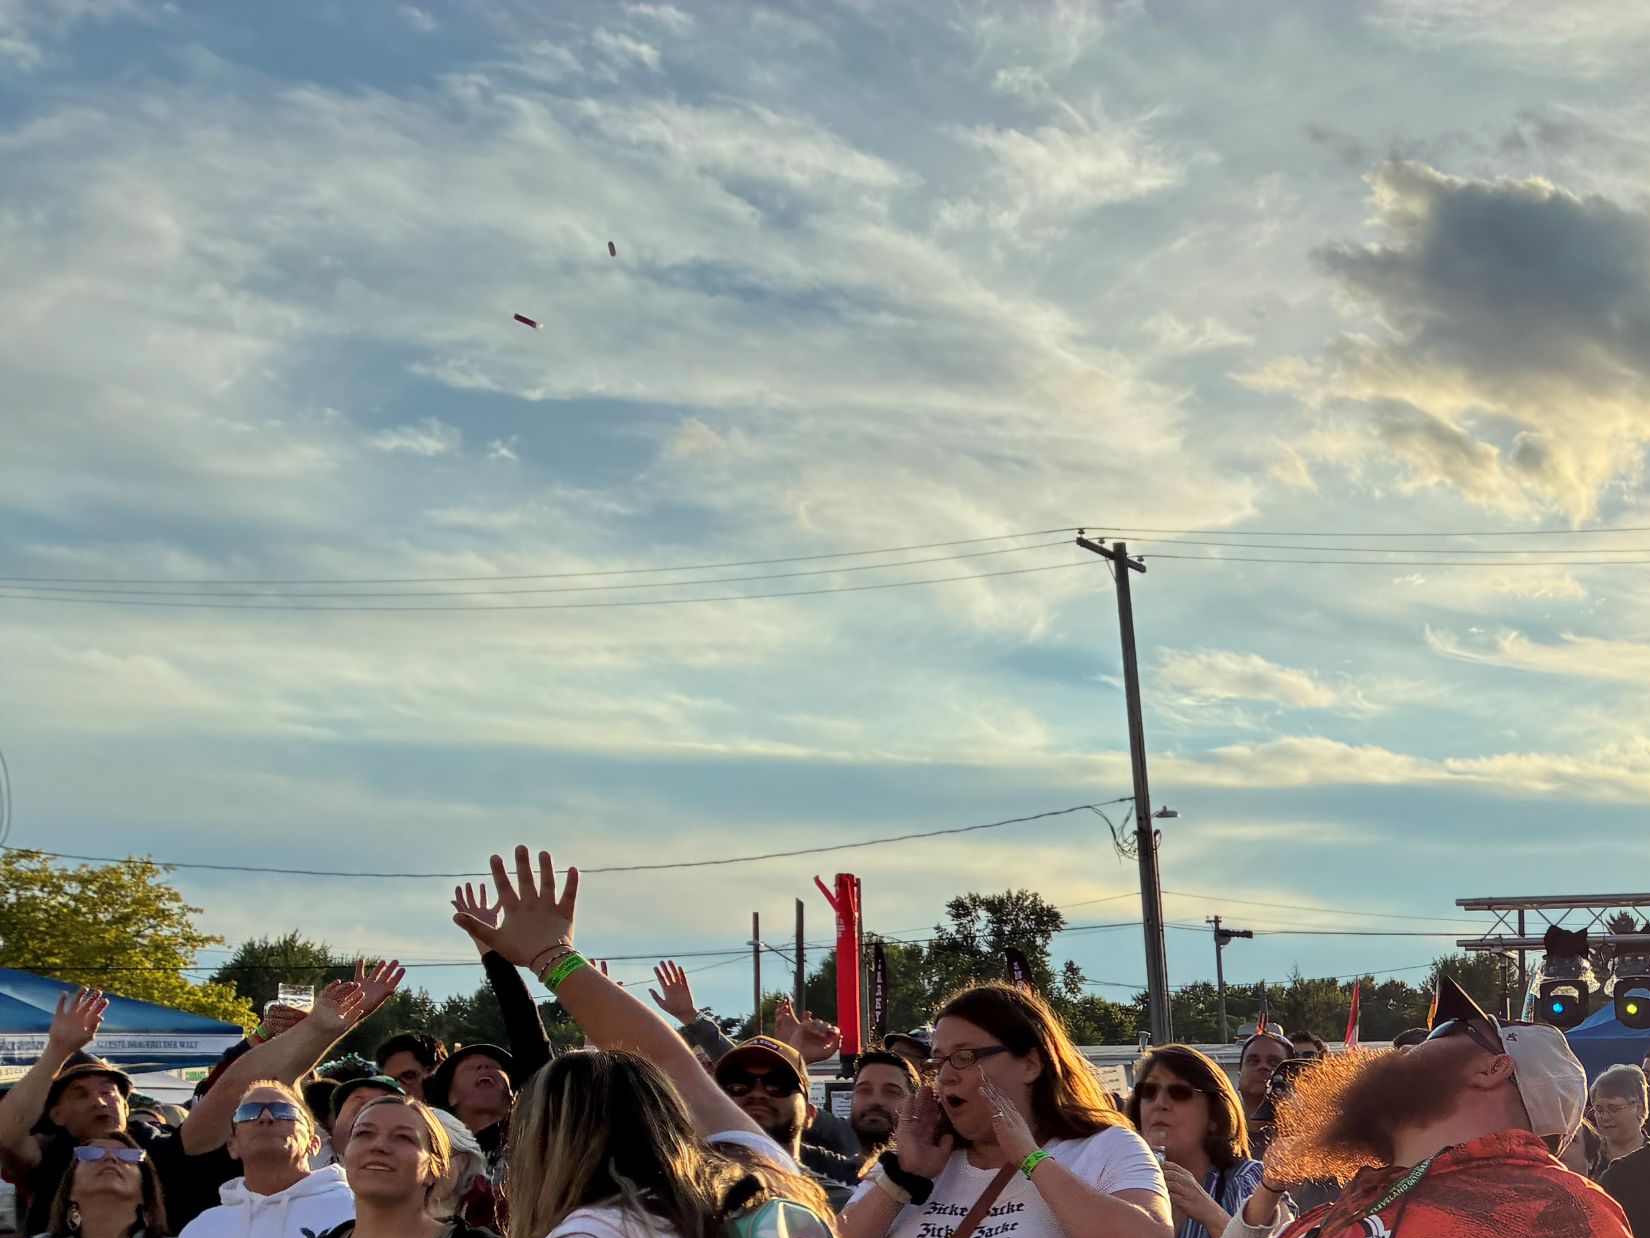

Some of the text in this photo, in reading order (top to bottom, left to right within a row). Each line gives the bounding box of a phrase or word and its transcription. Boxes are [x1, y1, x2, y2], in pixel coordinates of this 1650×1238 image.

[1369, 1182, 1409, 1215] CLEVELAND
[986, 1202, 1025, 1218] acke
[916, 1222, 955, 1238] Zick
